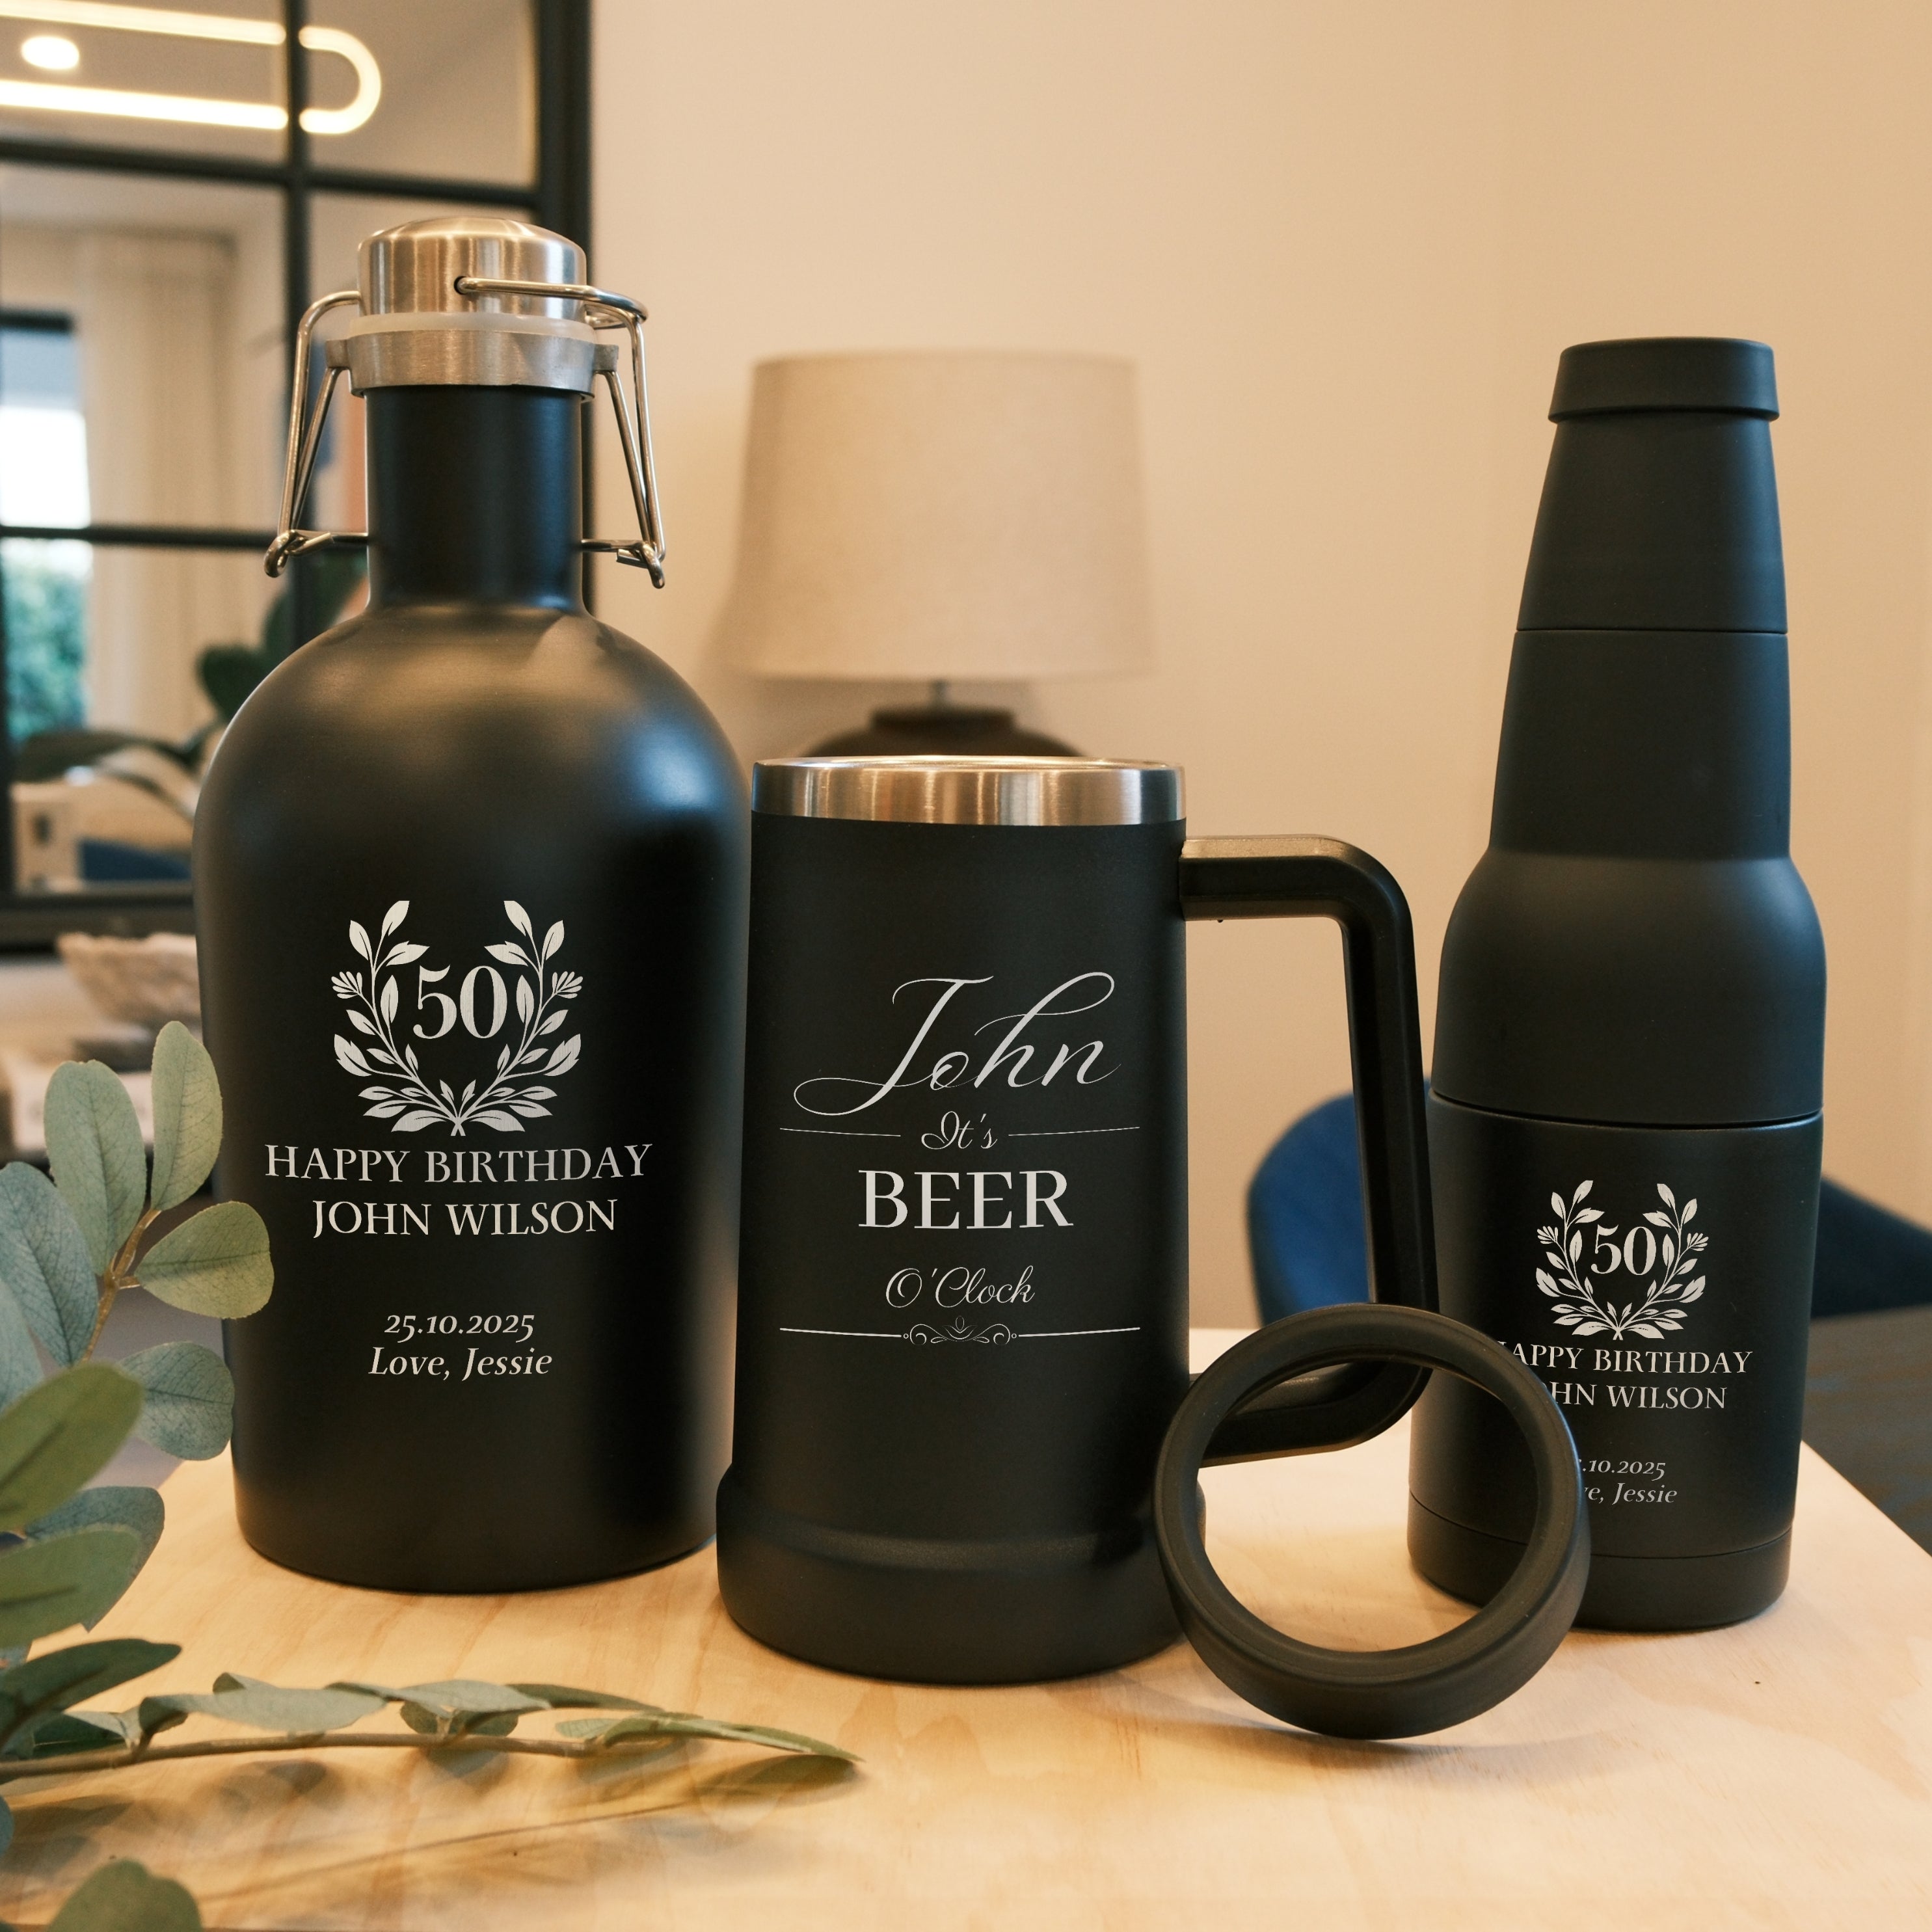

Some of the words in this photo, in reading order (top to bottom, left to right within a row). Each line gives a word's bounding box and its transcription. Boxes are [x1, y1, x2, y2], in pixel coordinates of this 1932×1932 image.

[412, 965, 507, 1040] 50
[793, 972, 1122, 1116] John
[921, 1110, 998, 1150] It's
[265, 1144, 410, 1183] HAPPY
[425, 1144, 652, 1183] BIRTHDAY
[313, 1200, 432, 1239] JOHN
[445, 1199, 618, 1235] WILSON
[858, 1170, 1074, 1229] BEER
[1590, 1224, 1657, 1276] 50
[885, 1265, 1036, 1308] O'Clock
[384, 1315, 535, 1343] 25.10.2025
[368, 1347, 449, 1381] Love,
[461, 1347, 552, 1382] Jessie
[1497, 1341, 1584, 1369] APPY
[1592, 1348, 1753, 1374] BIRTHDAY
[1542, 1381, 1598, 1406] HN
[1605, 1385, 1728, 1410] WILSON
[1579, 1458, 1666, 1481] .10.2025
[1611, 1483, 1678, 1505] Jessie
